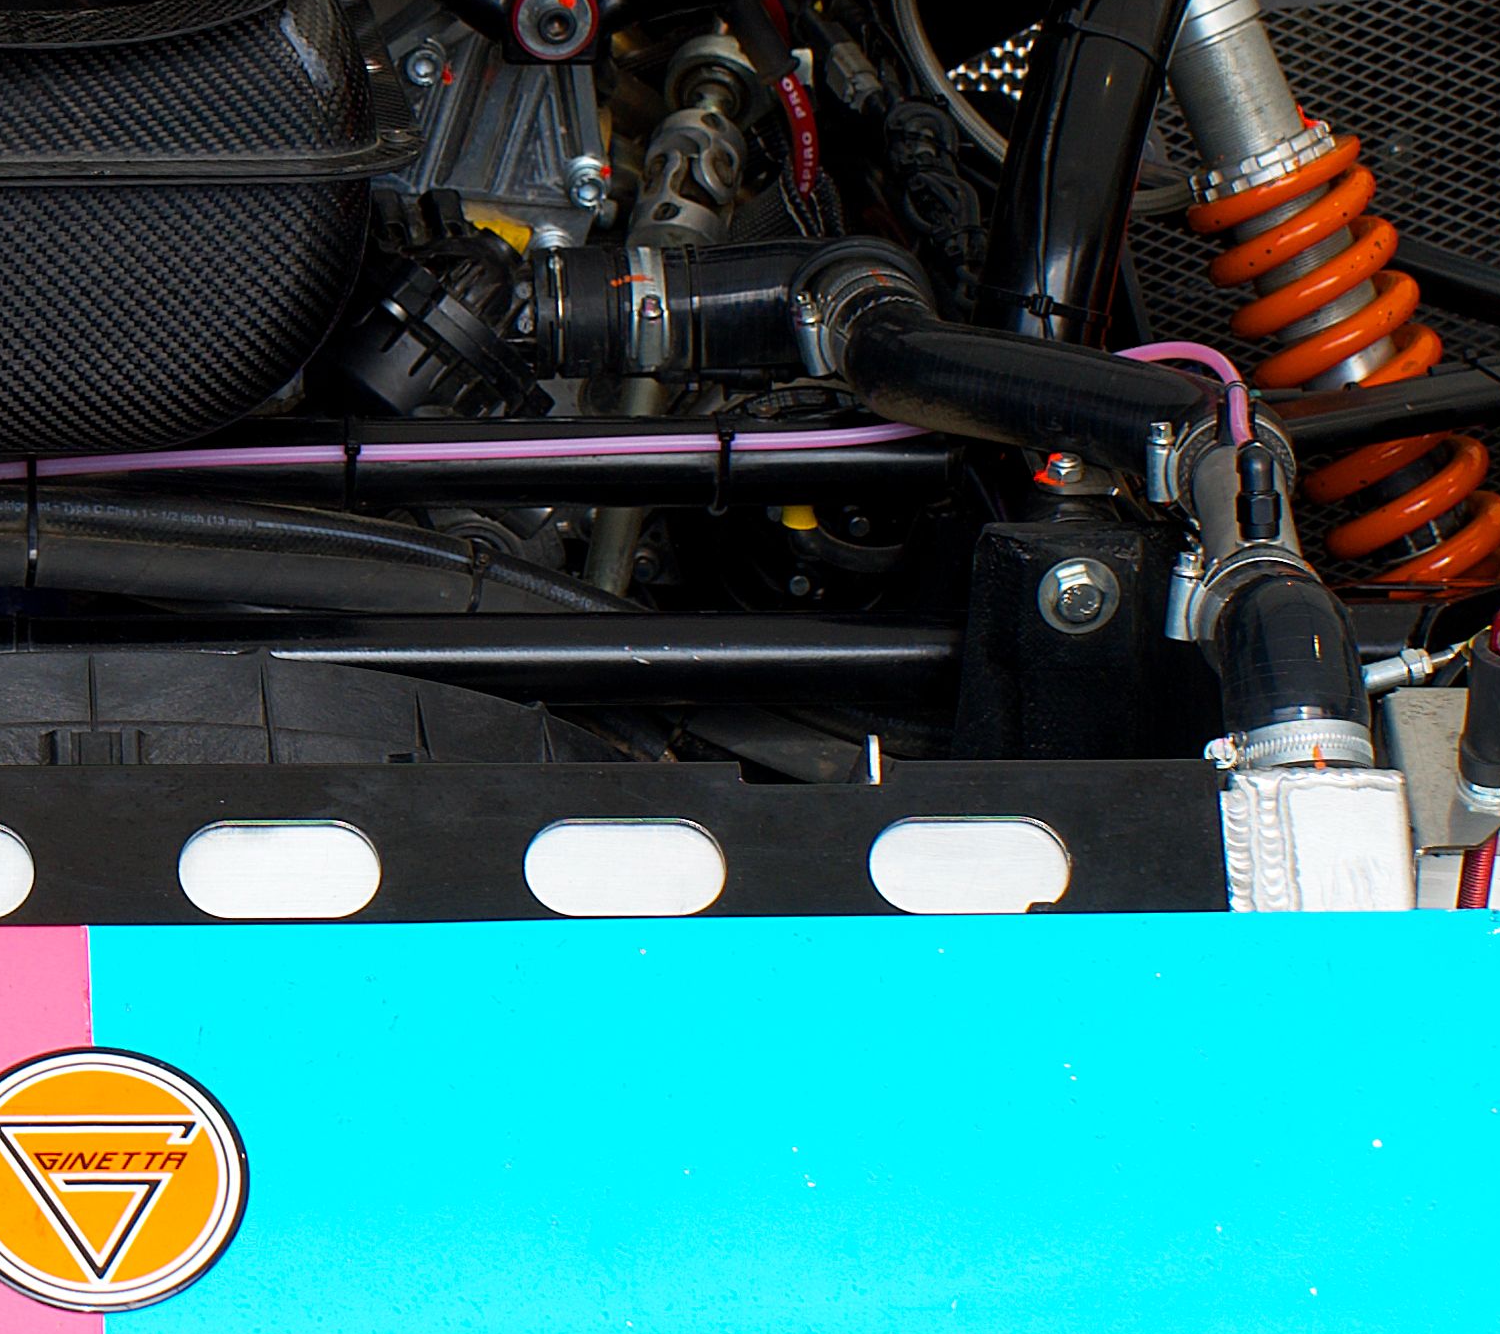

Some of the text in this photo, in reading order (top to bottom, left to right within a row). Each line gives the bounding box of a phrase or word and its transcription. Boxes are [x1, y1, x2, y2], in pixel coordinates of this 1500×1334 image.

[61, 502, 91, 517] Type
[180, 511, 204, 526] inch
[33, 1151, 188, 1171] GINETTA
